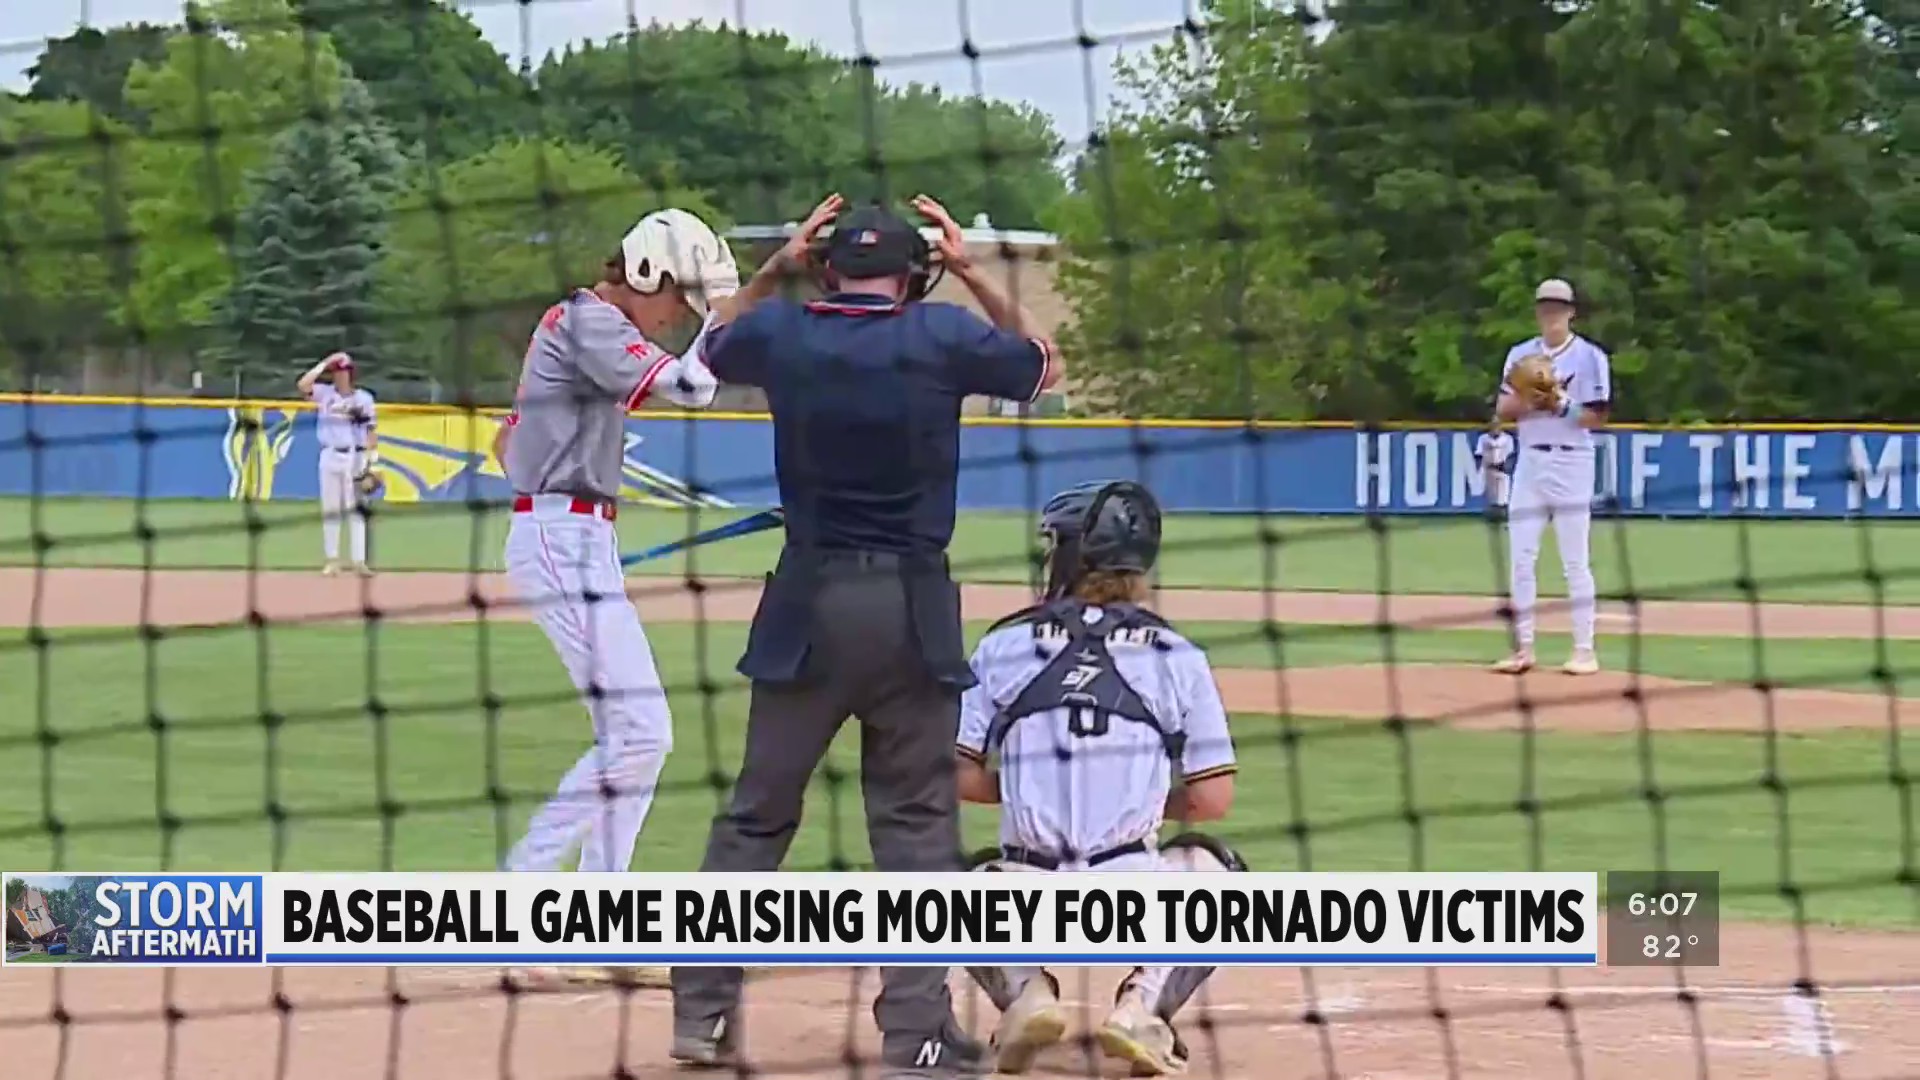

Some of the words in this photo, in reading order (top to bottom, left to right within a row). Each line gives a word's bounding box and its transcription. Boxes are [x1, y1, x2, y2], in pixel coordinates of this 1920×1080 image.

[1356, 432, 1488, 507] HOM
[1690, 433, 1816, 509] THE
[1847, 434, 1920, 510] M
